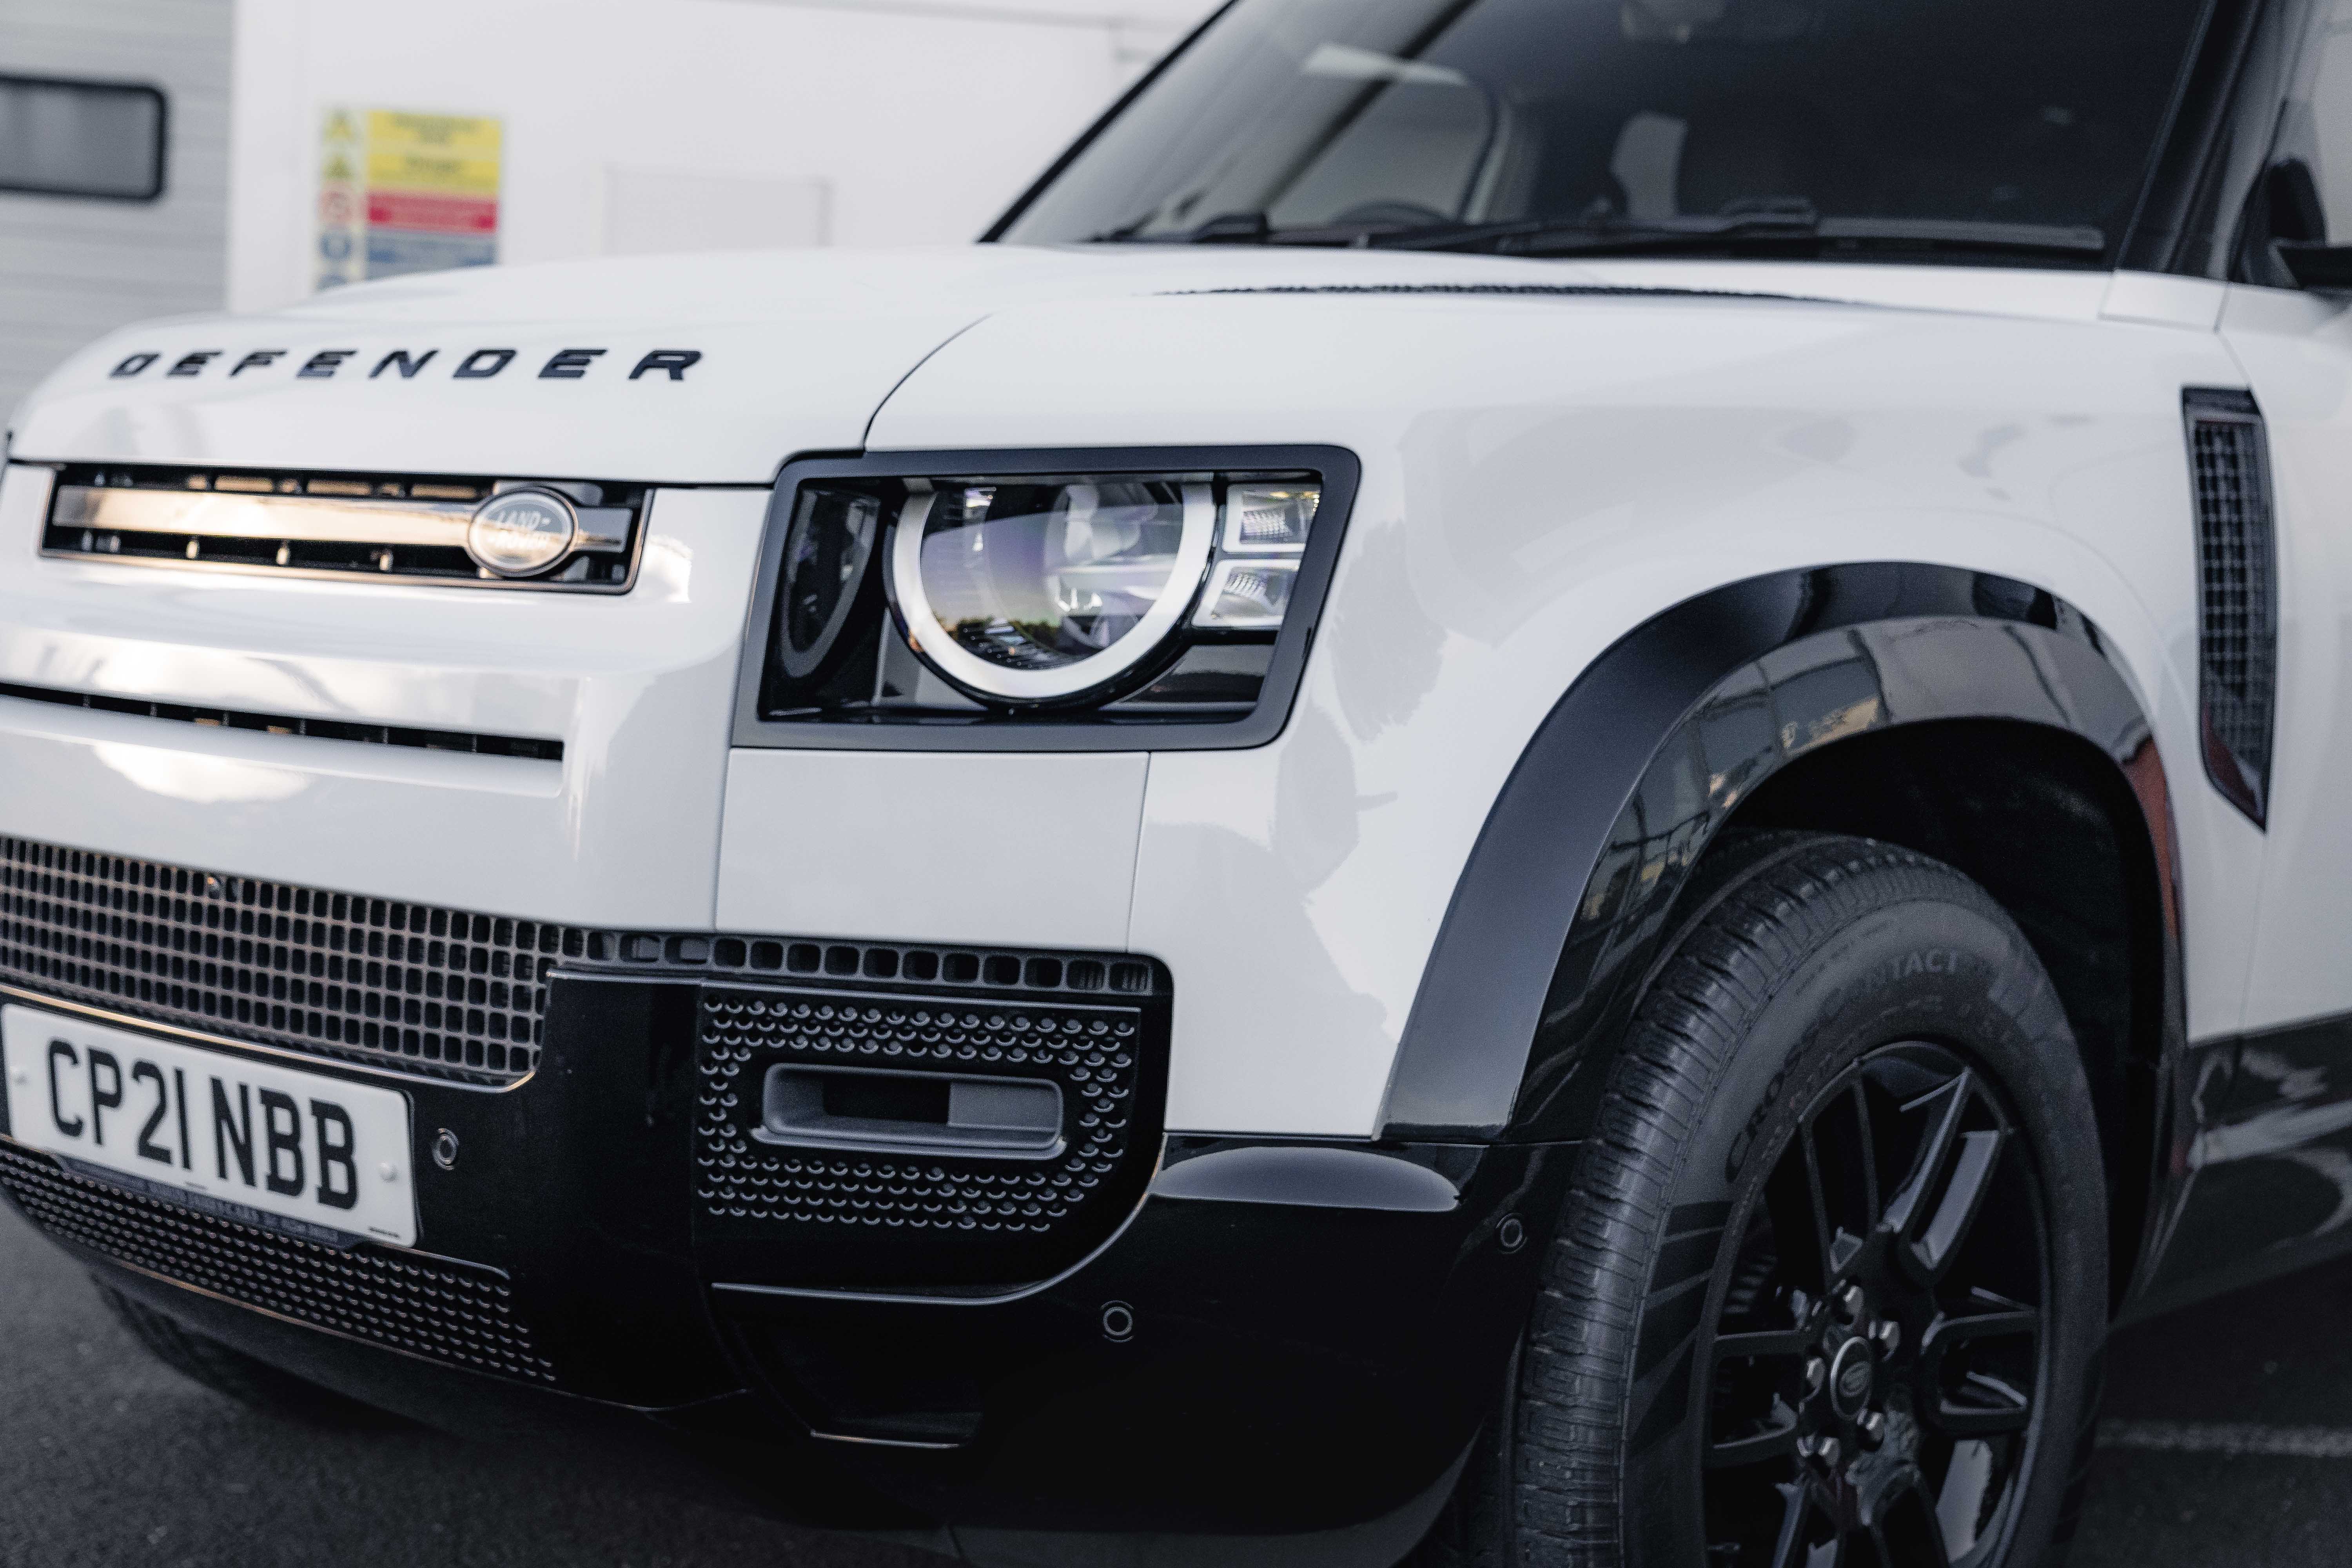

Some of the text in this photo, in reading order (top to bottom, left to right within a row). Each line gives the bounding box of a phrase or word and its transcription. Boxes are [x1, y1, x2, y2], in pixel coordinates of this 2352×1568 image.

[110, 348, 702, 381] DEFENDER
[47, 1039, 359, 1211] CP21 NBB
